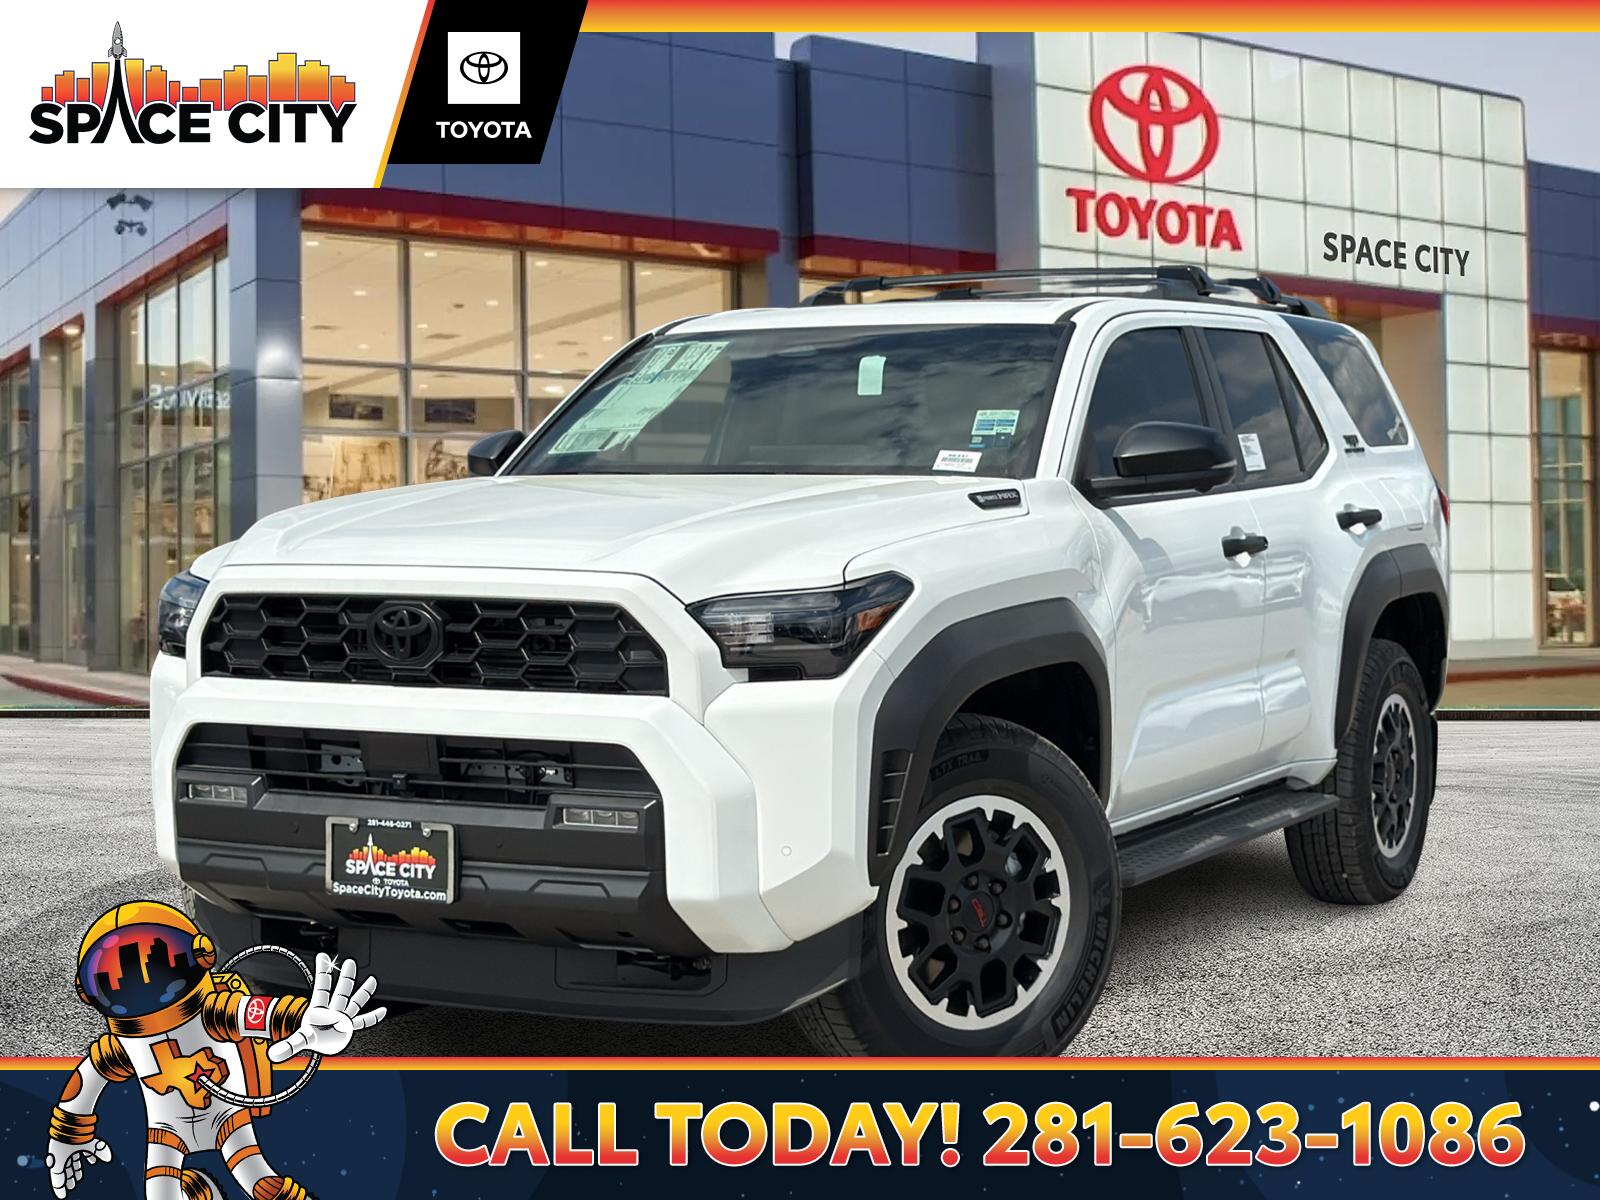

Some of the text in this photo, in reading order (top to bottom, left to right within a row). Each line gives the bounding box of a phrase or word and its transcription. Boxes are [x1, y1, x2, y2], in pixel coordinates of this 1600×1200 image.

[1065, 187, 1242, 251] TOYOTA
[1323, 231, 1470, 276] SPACE CITY
[345, 845, 436, 880] SPACE CITY
[383, 878, 410, 887] TOYOTA
[333, 881, 447, 901] SpaceCityToyota.com
[1054, 915, 1109, 1033] MICHELIN
